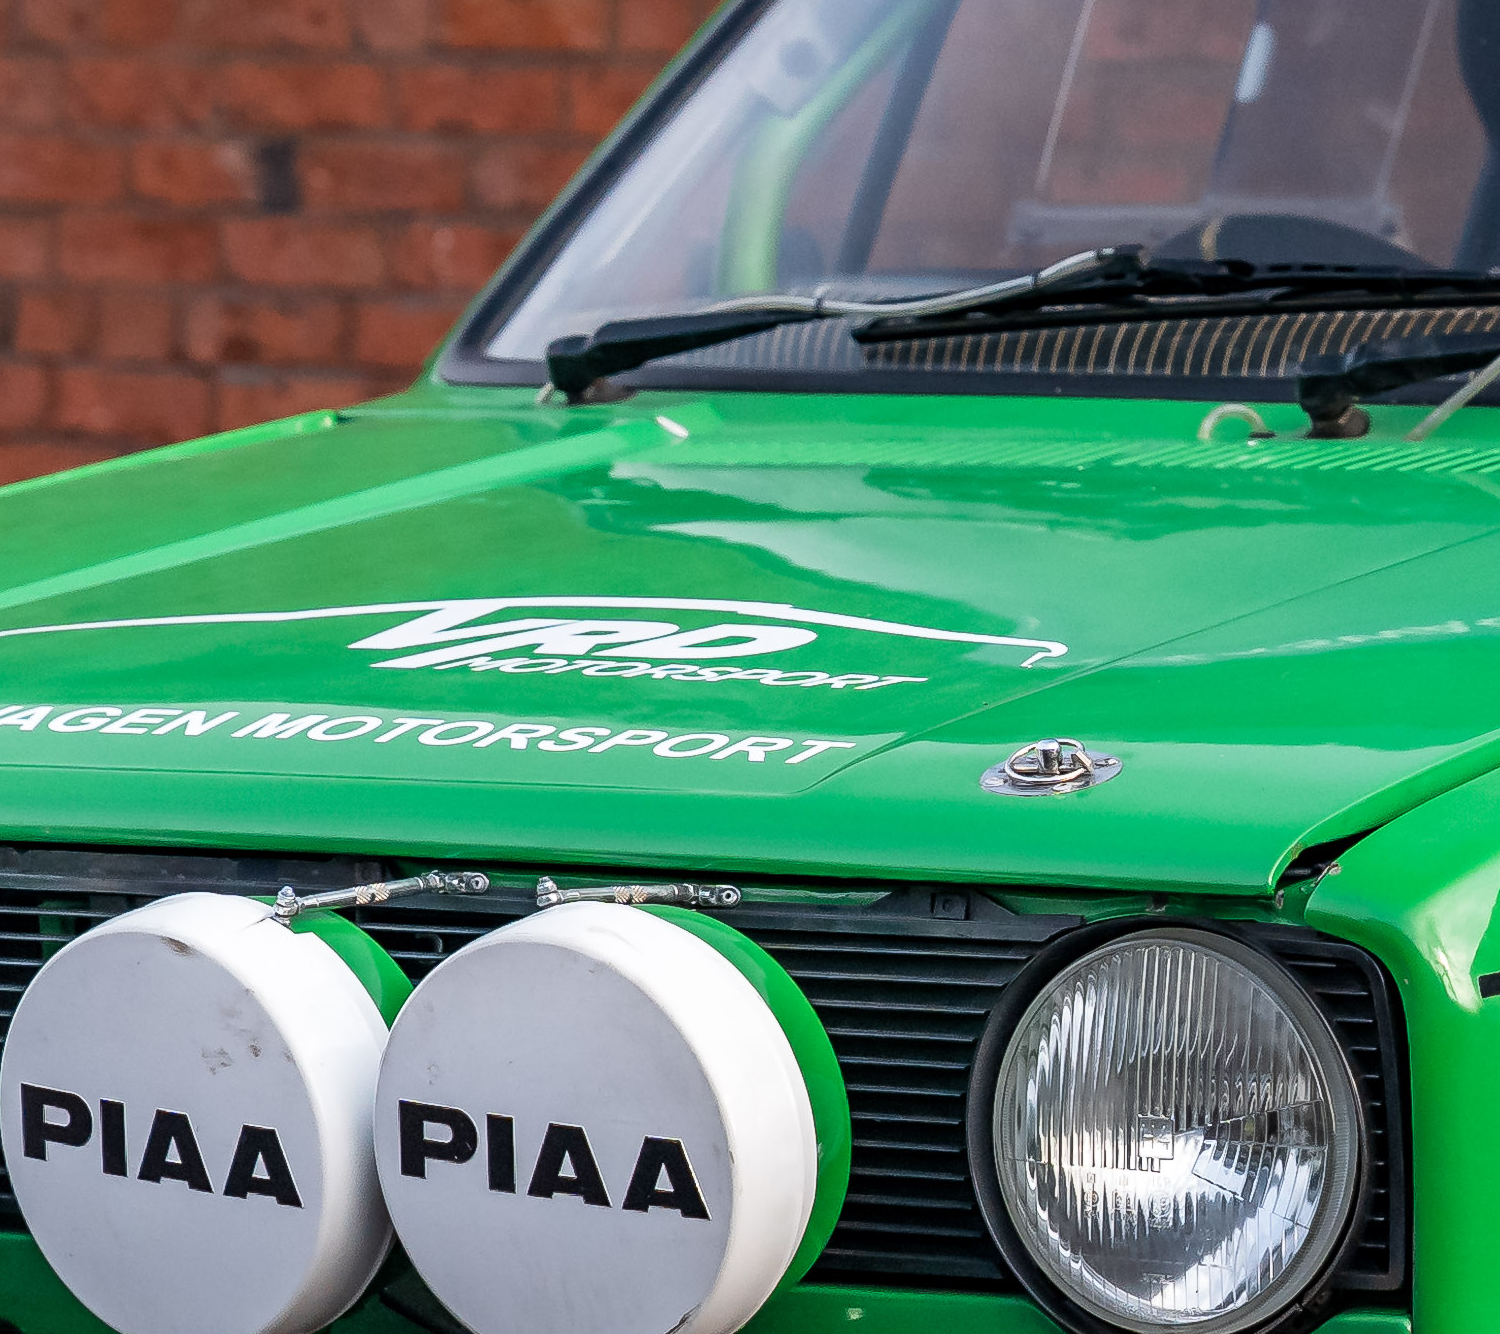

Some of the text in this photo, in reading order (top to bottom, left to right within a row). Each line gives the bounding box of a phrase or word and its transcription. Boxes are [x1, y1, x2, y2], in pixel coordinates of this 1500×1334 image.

[434, 656, 928, 690] MOTORSPORT
[234, 710, 854, 764] MOTORSPORT
[20, 1082, 304, 1209] PIAA
[398, 1098, 712, 1221] PIAA
